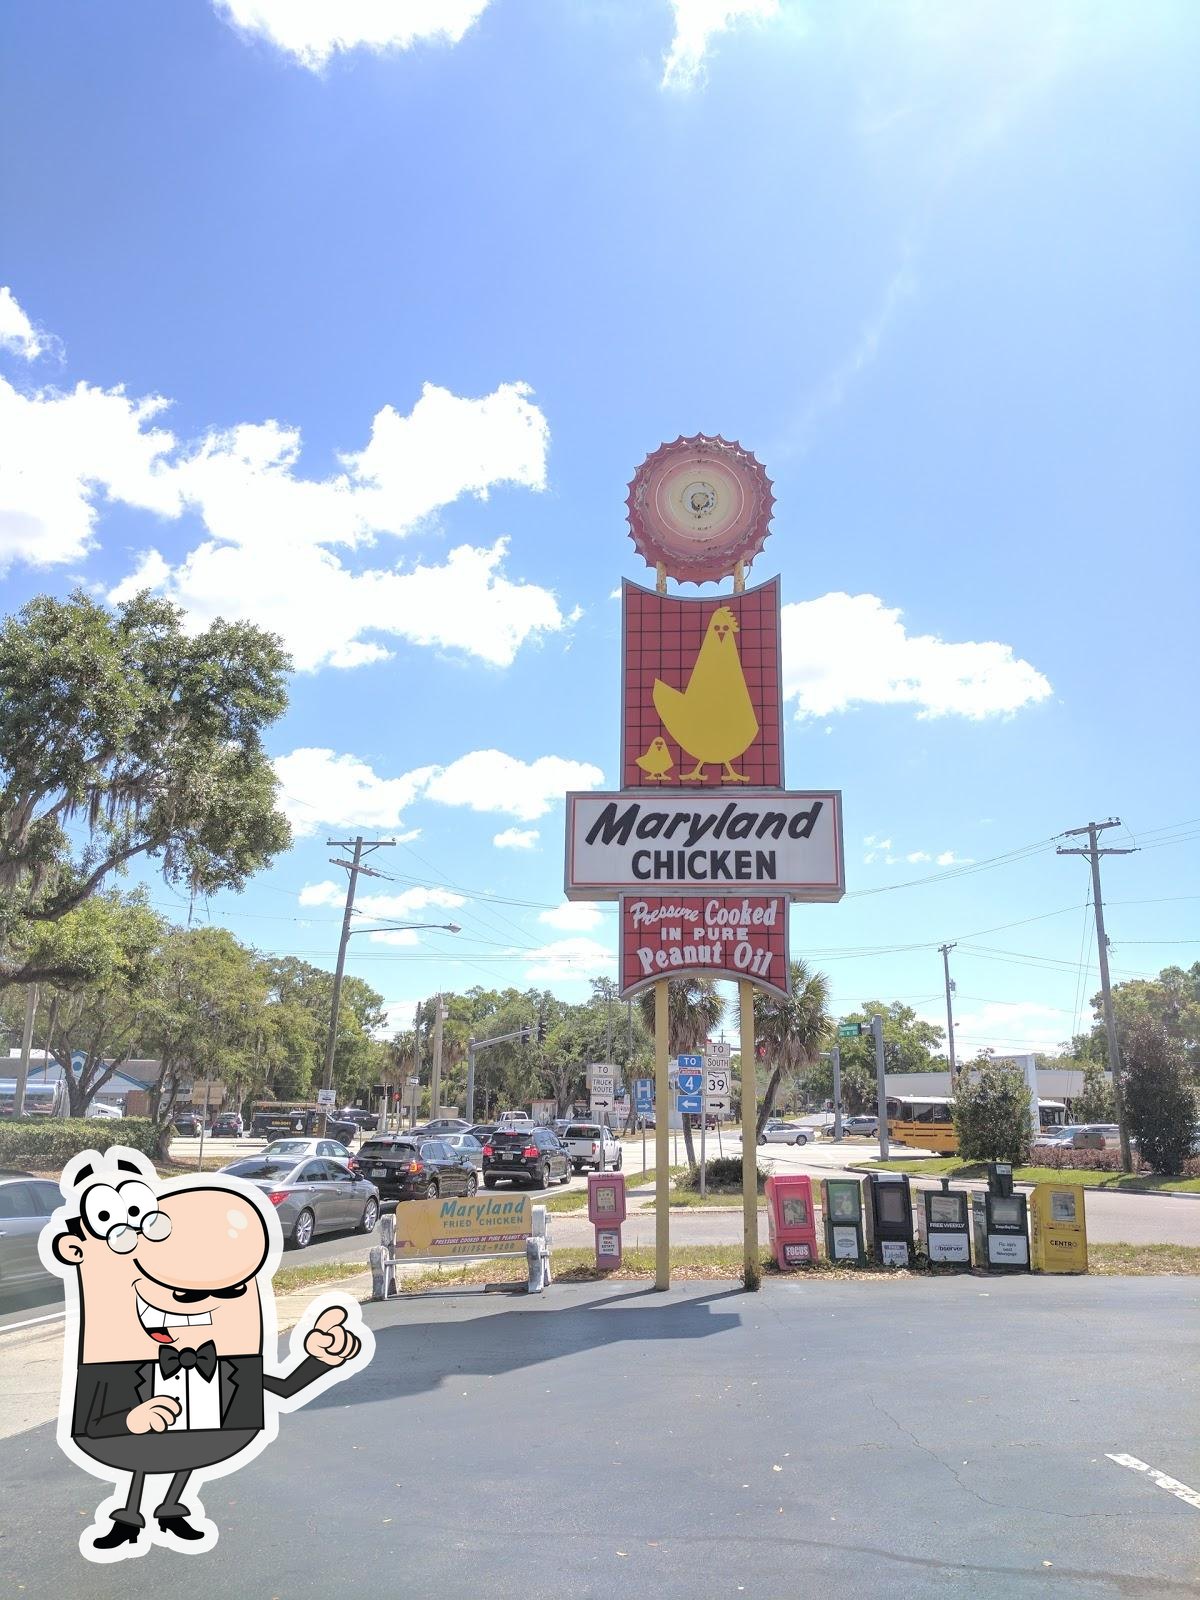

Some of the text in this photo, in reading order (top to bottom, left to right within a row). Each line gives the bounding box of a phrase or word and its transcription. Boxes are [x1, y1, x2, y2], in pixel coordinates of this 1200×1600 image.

[584, 801, 824, 847] Maryland
[631, 849, 777, 880] CHICKEN
[630, 899, 778, 929] Pressure Cooked
[661, 927, 749, 941] IN PURE
[636, 941, 773, 976] Peanut Oil
[684, 1057, 697, 1066] TO
[707, 1057, 729, 1067] SOUTH
[598, 1066, 609, 1074] TO
[685, 1076, 694, 1090] 4
[708, 1079, 725, 1091] 39
[440, 1196, 526, 1221] Maryland
[443, 1216, 523, 1229] FRIED CHICKEN
[1049, 1239, 1078, 1248] CENTRO
[785, 1245, 809, 1256] FOCUS
